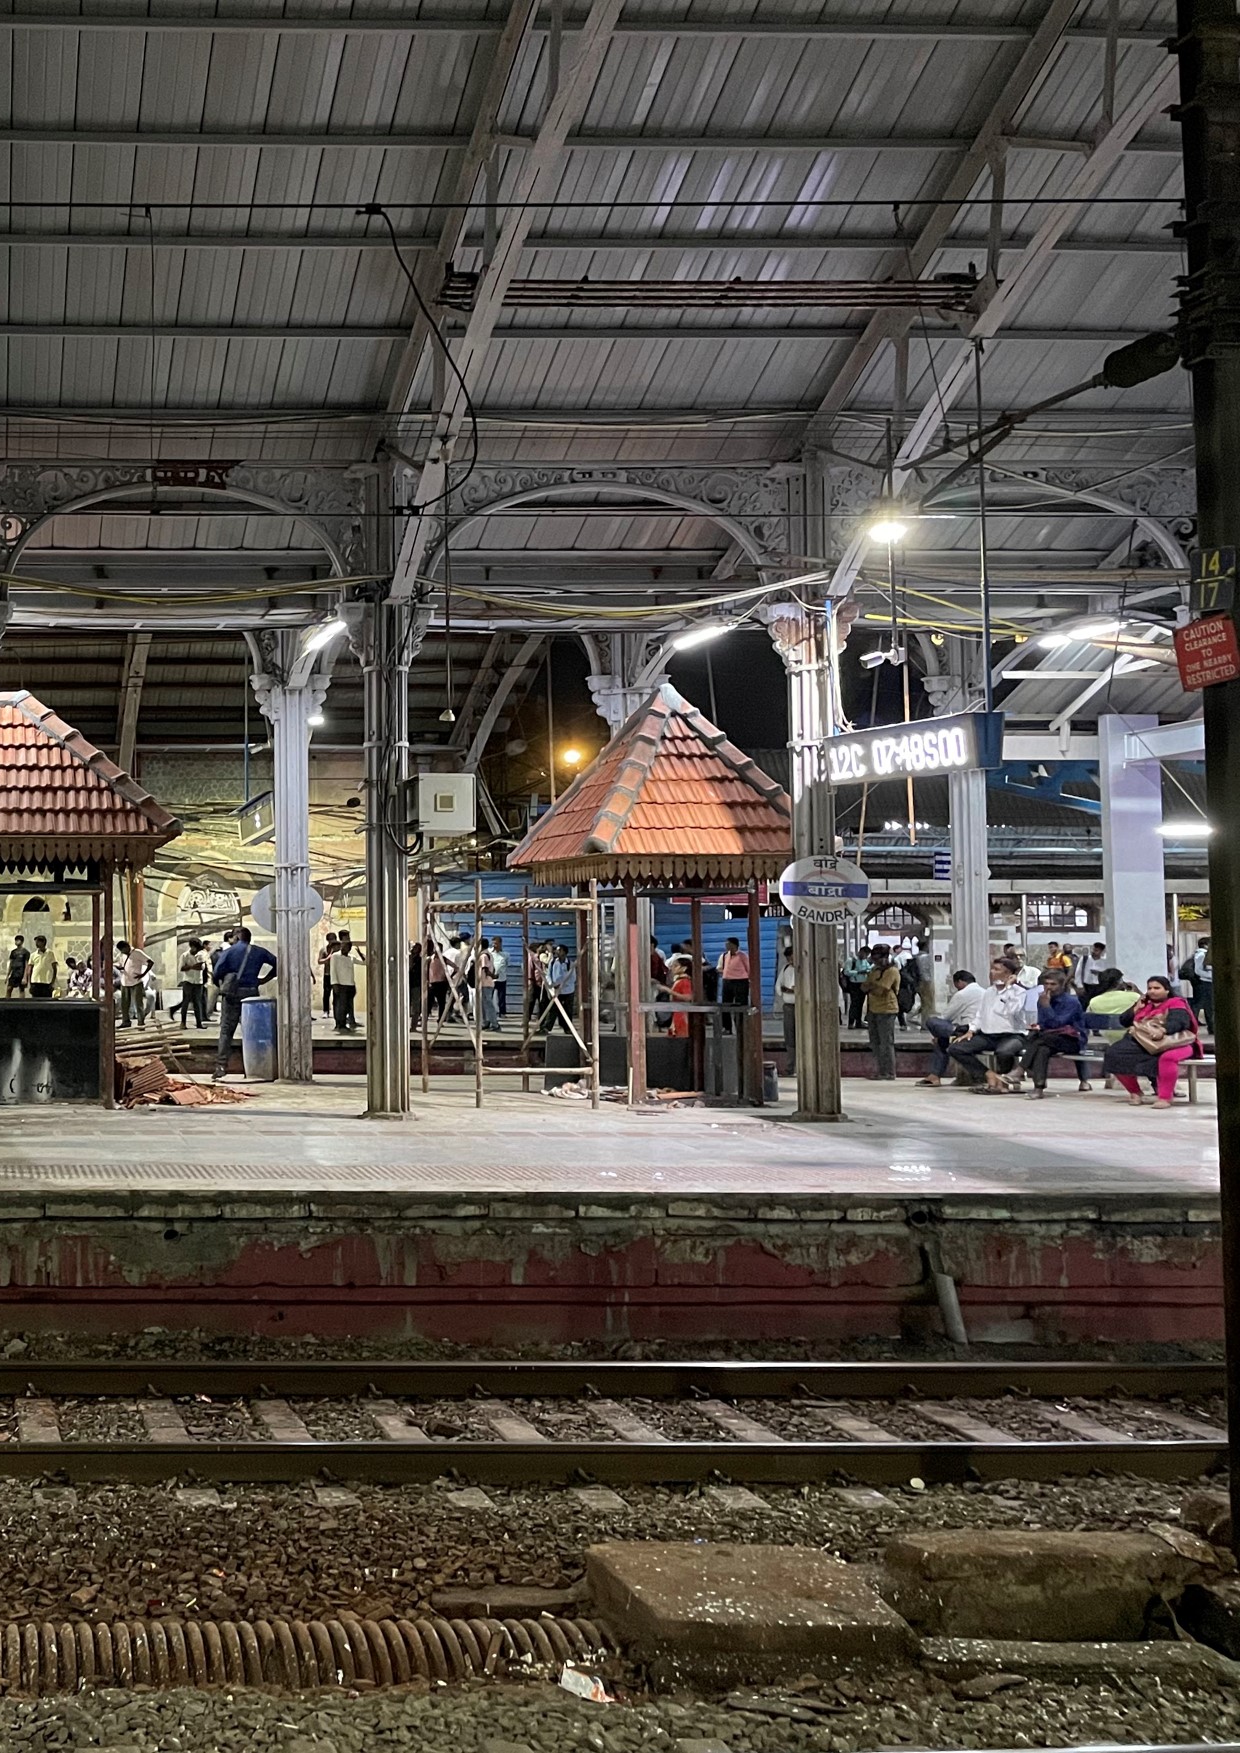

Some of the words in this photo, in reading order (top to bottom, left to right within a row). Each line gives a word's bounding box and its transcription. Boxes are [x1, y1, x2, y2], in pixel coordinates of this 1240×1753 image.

[1201, 550, 1220, 577] 14
[1200, 582, 1219, 609] 17
[1183, 620, 1224, 641] CAUTION
[1184, 632, 1227, 652] CLEARANCE
[1201, 648, 1213, 658] TO
[1203, 653, 1233, 668] NEARBY
[1186, 664, 1236, 685] RESTRICTED
[807, 881, 845, 898] बांद्रा
[797, 905, 855, 923] BANDRA
